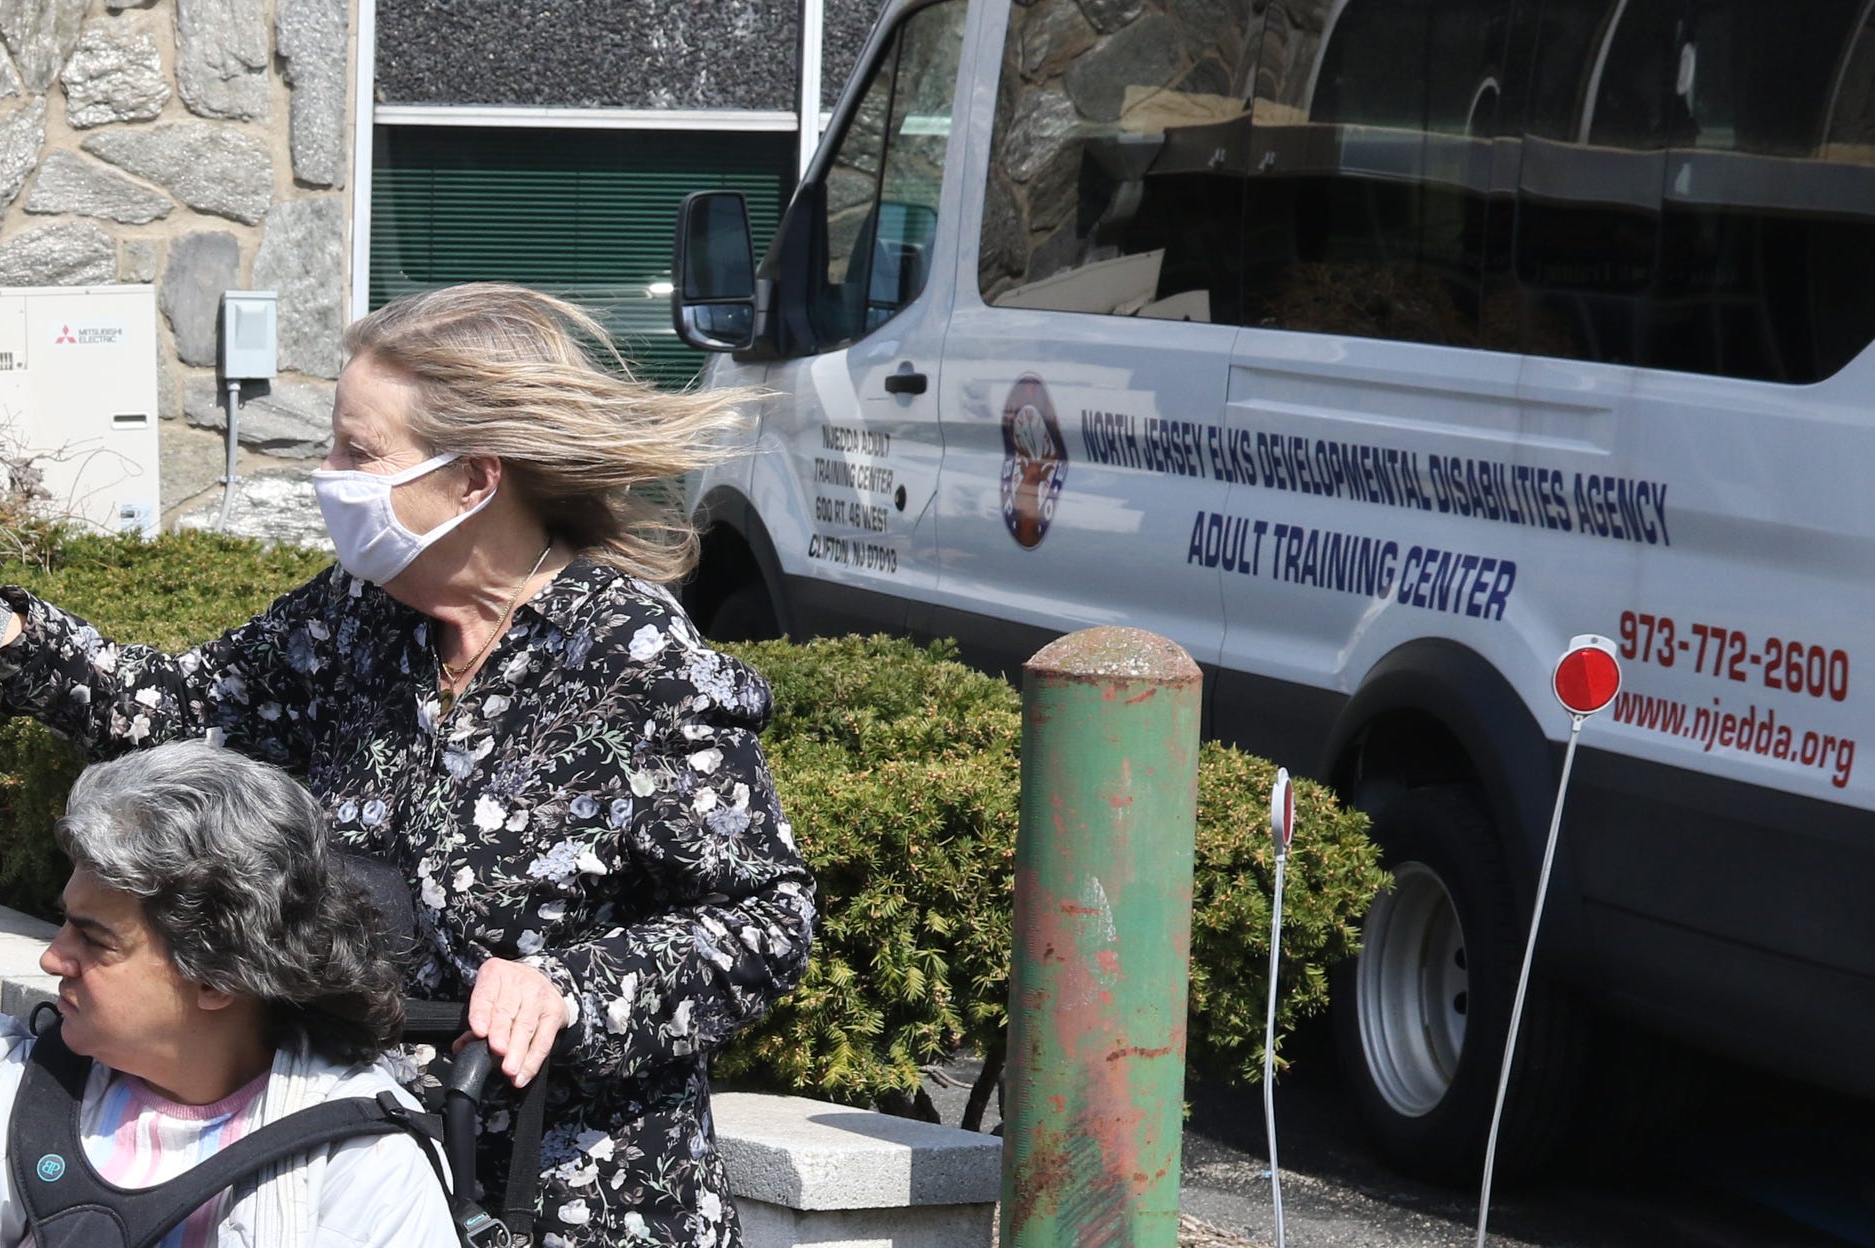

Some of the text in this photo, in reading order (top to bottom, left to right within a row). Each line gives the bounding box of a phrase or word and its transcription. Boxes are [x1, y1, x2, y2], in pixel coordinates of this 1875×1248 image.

[822, 424, 891, 458] NJEDDA ADULT
[814, 457, 894, 495] TRAINING CENTER
[1081, 409, 1671, 547] NORTH JERSEY ELKS DEVELOPMENTAL DISABILITIES AGENCY
[816, 496, 833, 523] 600
[849, 502, 861, 529] 46
[862, 504, 888, 533] WEST
[808, 534, 898, 574] CLIFTON, NJ 07013
[1187, 511, 1517, 621] ADULT TRAINING CENTER
[1619, 610, 1849, 702] 973-772-2600
[1613, 691, 1856, 788] www.njedda.org
